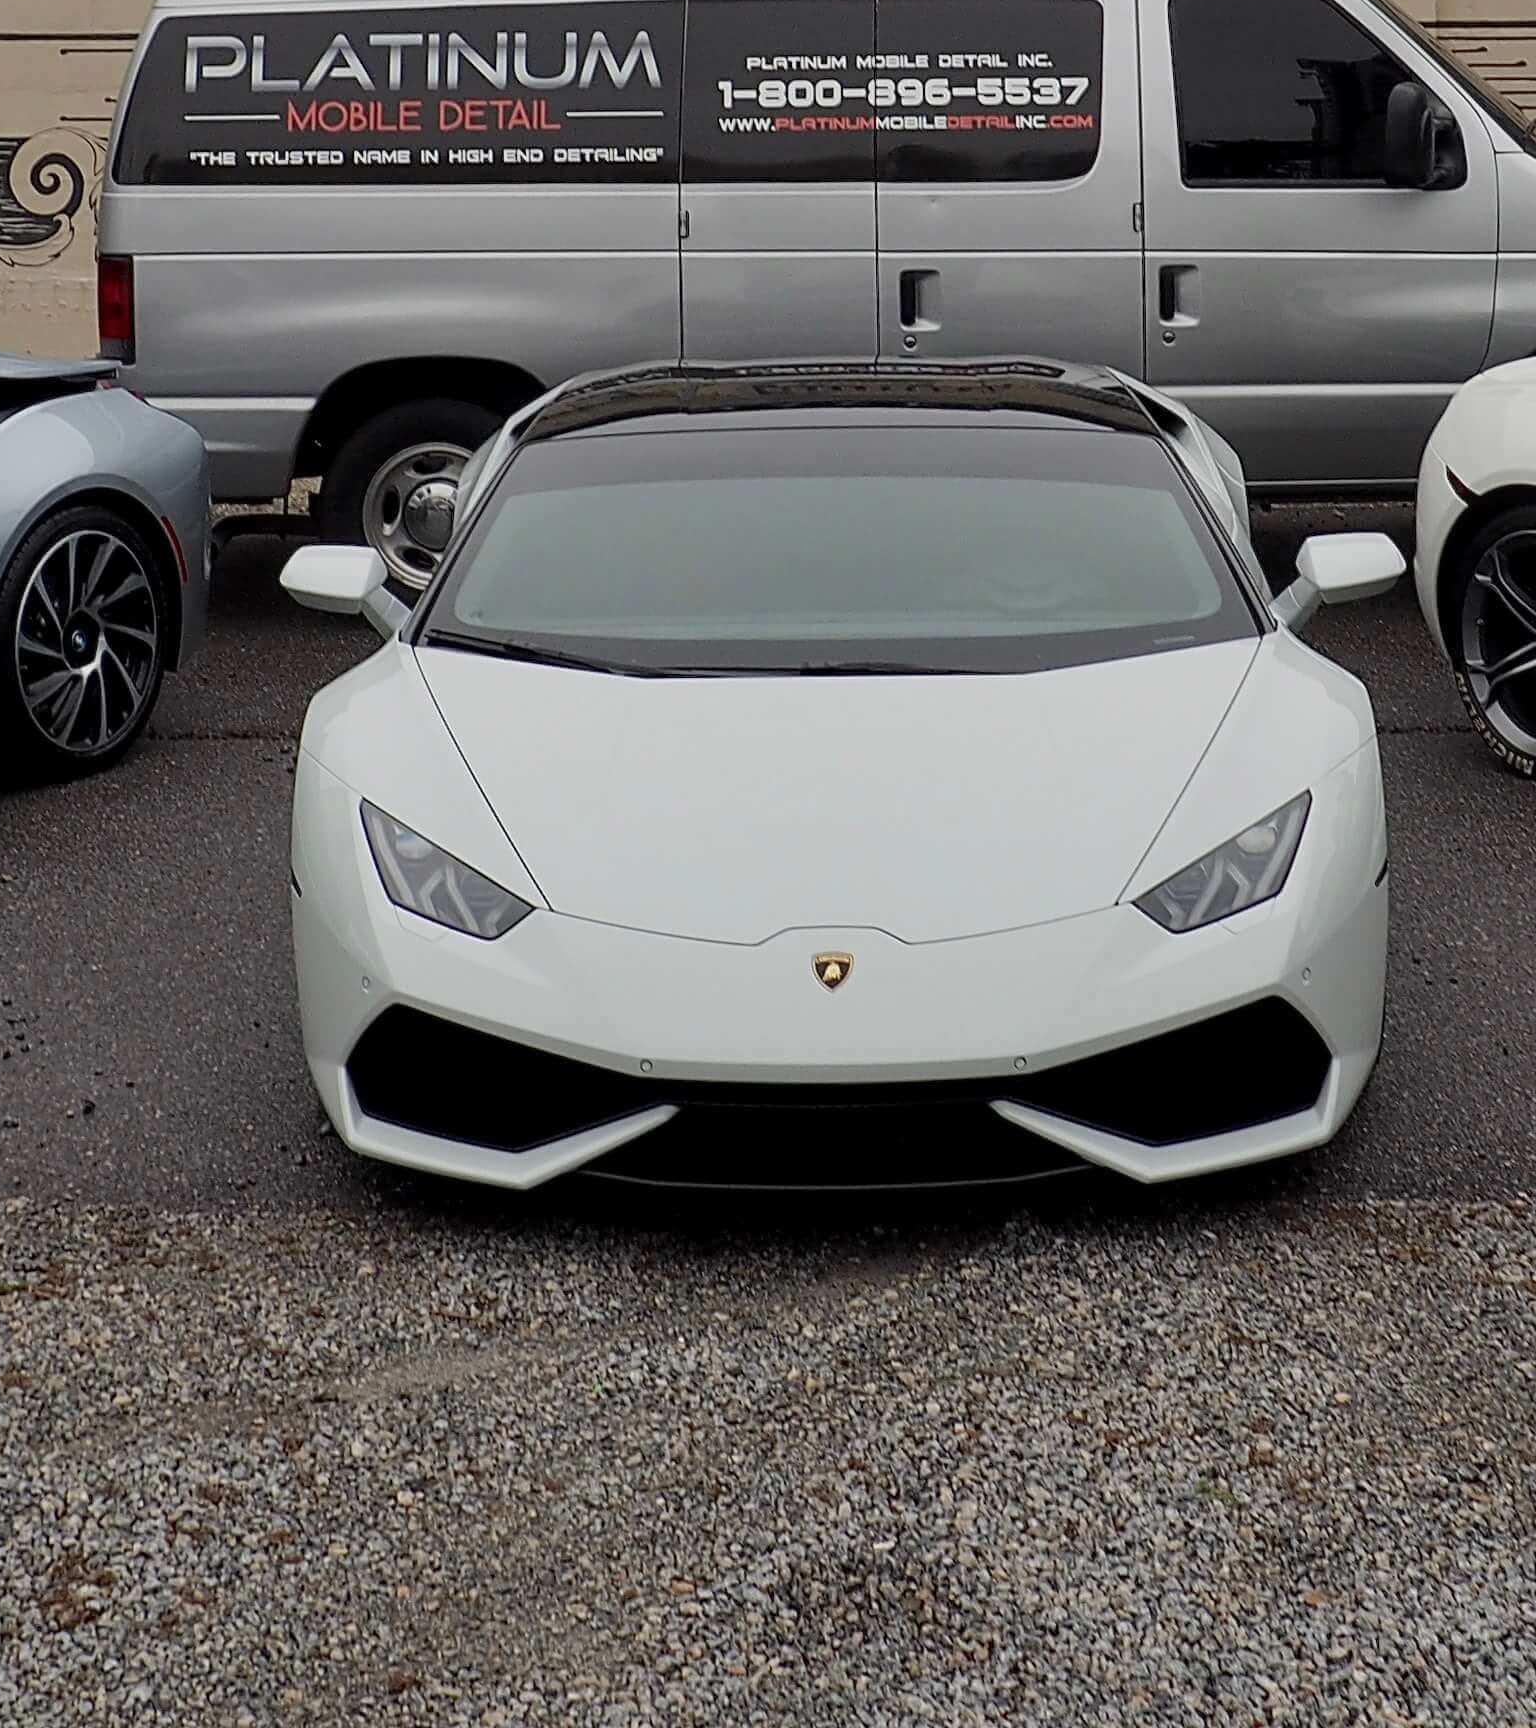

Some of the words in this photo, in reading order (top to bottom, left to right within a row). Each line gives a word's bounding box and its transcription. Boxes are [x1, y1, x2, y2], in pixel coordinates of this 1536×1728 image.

[184, 30, 662, 92] PLATINUM
[746, 54, 847, 71] PLATINUM
[856, 53, 929, 69] MOBILE
[938, 53, 1008, 69] DETAIL
[1017, 53, 1053, 69] INC.
[717, 77, 1089, 110] 1-800-896-5537
[286, 99, 423, 133] MOBILE
[440, 98, 561, 132] DETAIL
[718, 114, 1093, 133] WWW.PLATINUMMOBILEDETAILINC.COM
[189, 151, 236, 166] "THE
[246, 150, 344, 166] TRUSTED
[353, 149, 411, 165] NAME
[420, 149, 439, 164] IN
[448, 148, 493, 164] HIGH
[503, 148, 543, 163] END
[553, 147, 663, 163] DETAILING"
